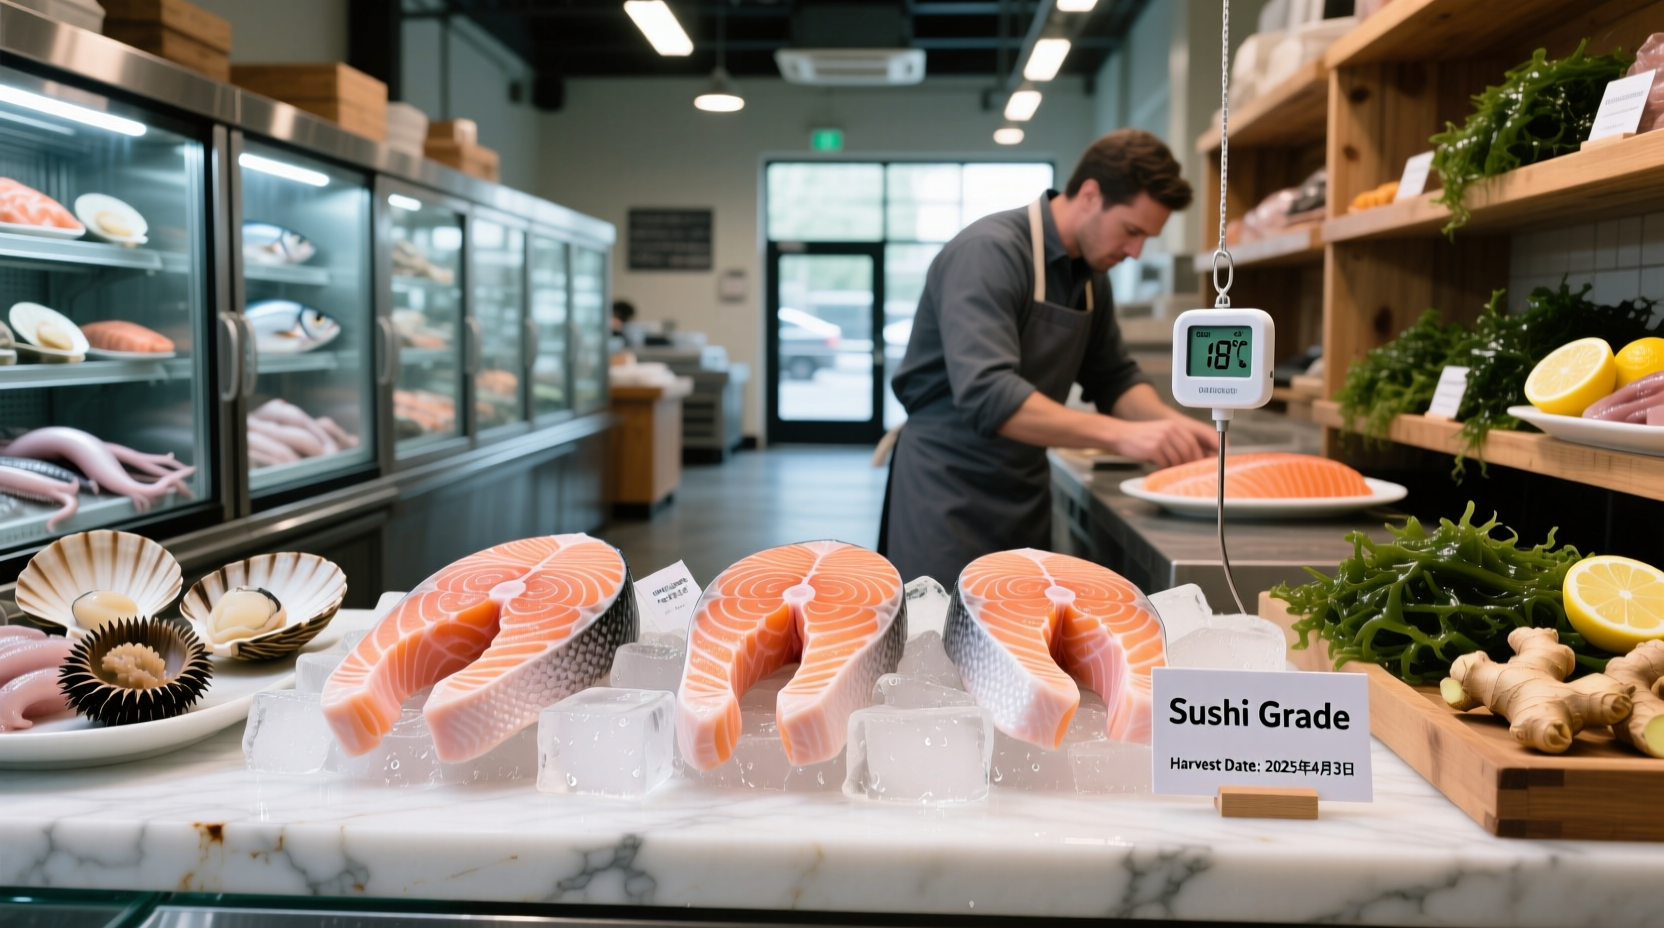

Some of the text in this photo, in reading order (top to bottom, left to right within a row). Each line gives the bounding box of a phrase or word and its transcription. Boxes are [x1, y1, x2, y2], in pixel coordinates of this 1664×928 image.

[1169, 697, 1351, 730] Sushi Grade
[1170, 757, 1355, 776] Harvest Date: 2025年4月3日
